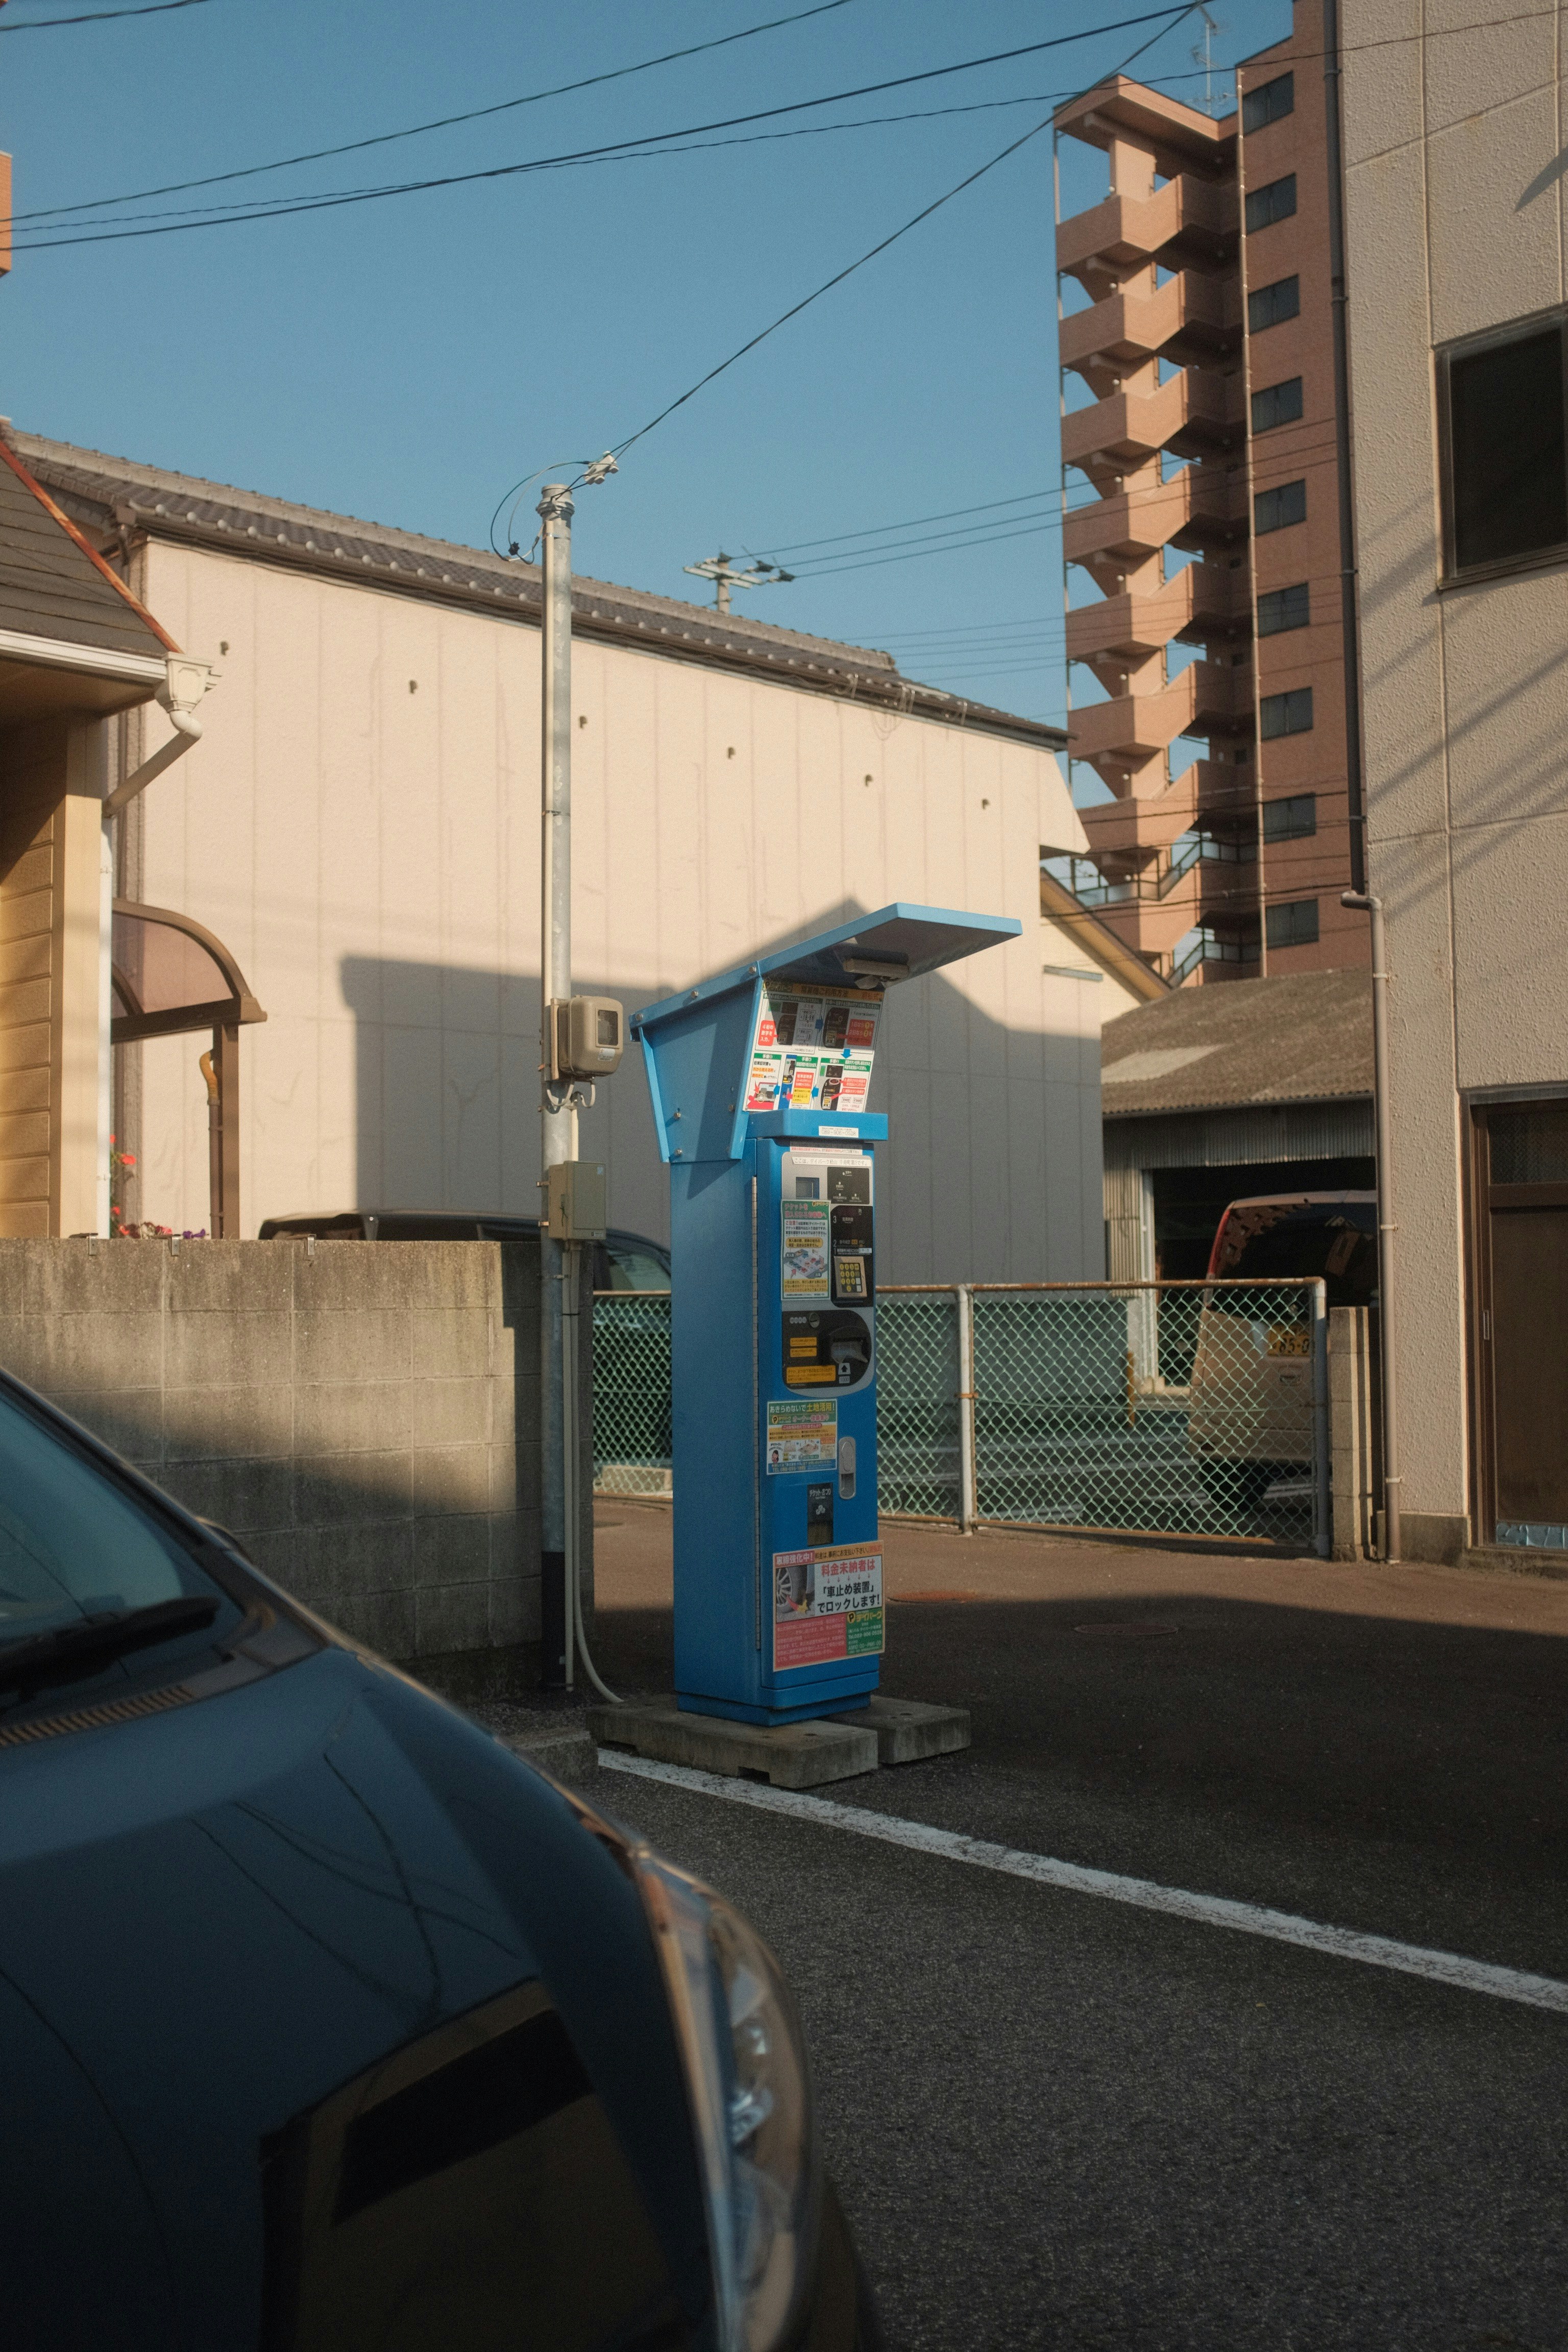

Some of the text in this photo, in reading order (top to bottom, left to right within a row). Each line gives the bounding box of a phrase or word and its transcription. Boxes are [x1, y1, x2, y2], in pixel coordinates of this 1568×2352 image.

[821, 1558, 876, 1577] 料金未納者は
[823, 1581, 874, 1598] 「車止め装置」
[817, 1594, 880, 1613] でロックします!
